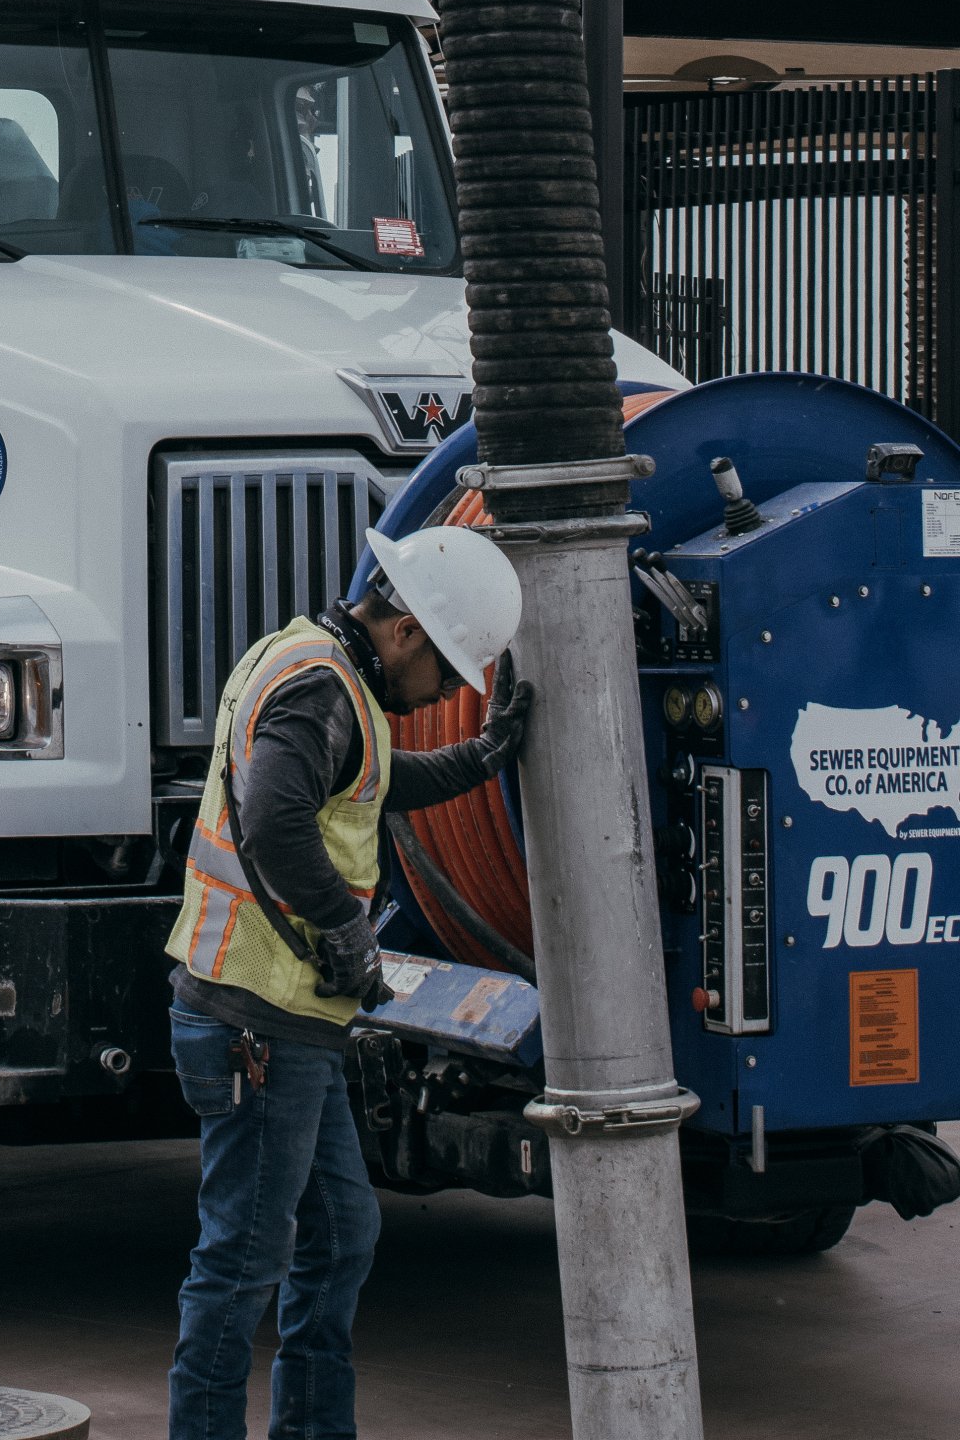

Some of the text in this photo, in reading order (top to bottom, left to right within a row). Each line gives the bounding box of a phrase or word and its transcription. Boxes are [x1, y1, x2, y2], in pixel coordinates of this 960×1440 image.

[809, 745, 960, 771] SEWER EQUIPMENT
[825, 771, 949, 796] CO. of AMERICA
[899, 829, 908, 841] by
[908, 828, 929, 838] SEWER
